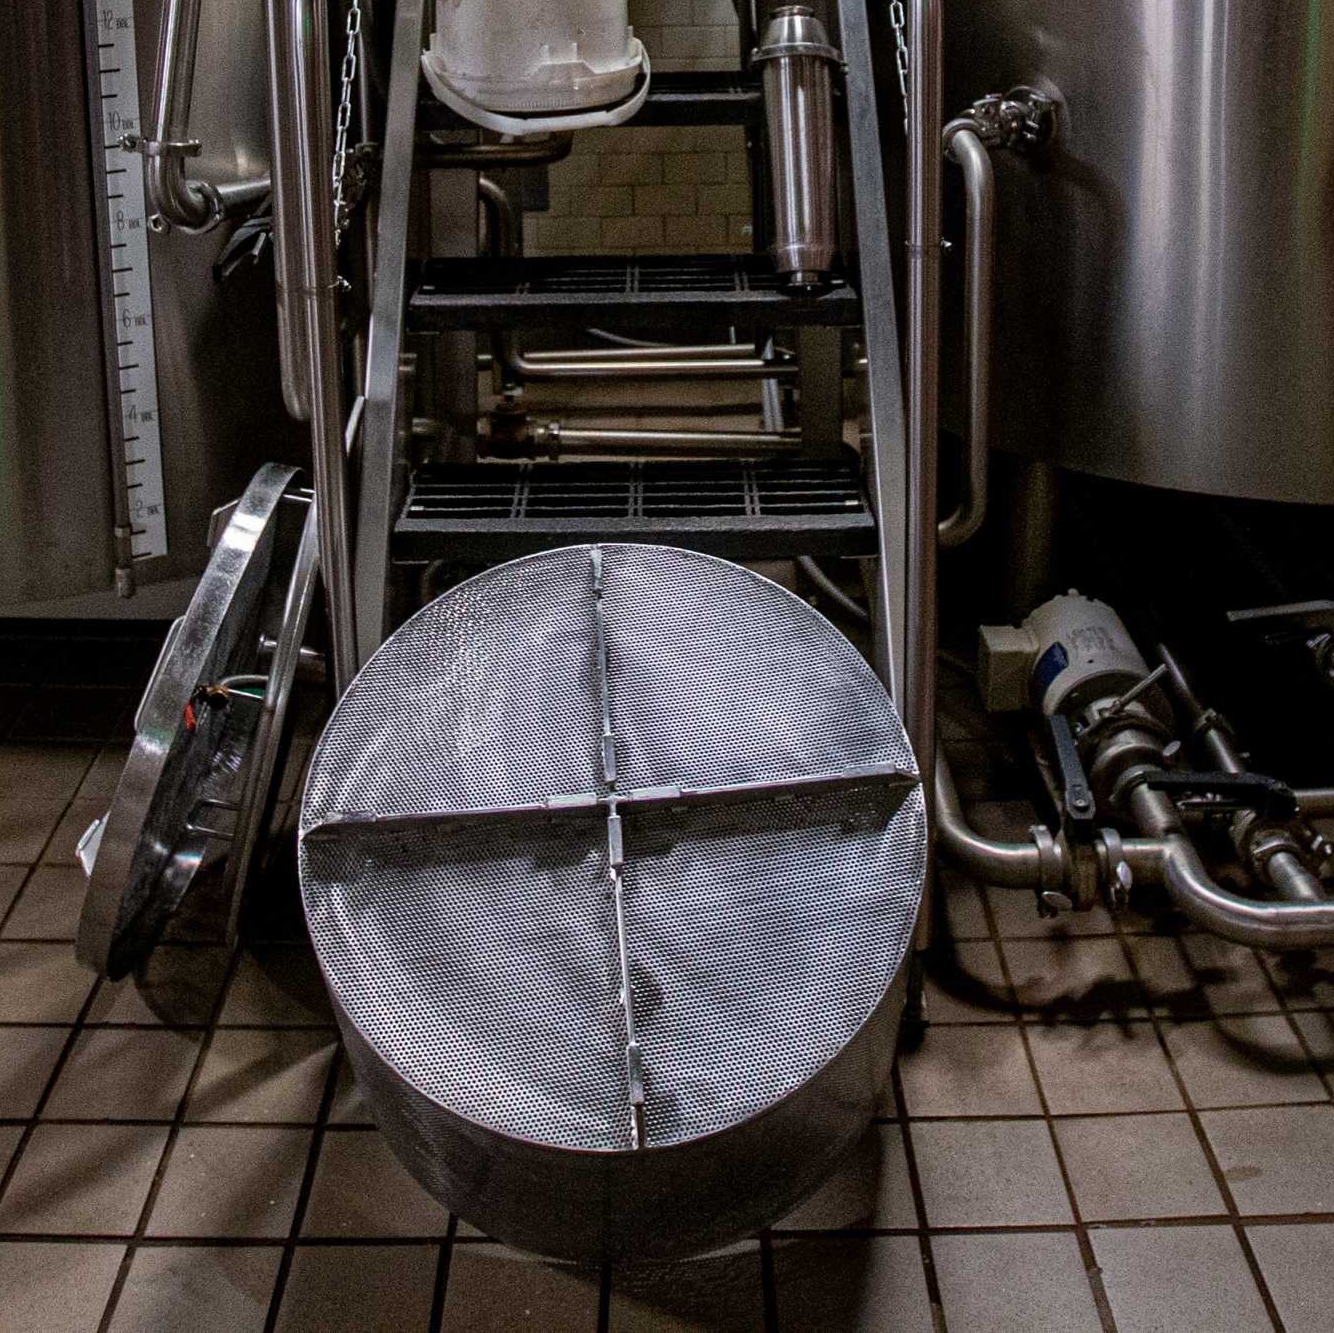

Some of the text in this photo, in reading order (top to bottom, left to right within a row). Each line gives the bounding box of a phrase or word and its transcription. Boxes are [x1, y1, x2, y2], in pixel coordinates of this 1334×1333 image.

[102, 9, 114, 30] 12
[109, 111, 121, 131] 10
[116, 210, 125, 231] 8
[122, 308, 131, 328] 6
[129, 405, 137, 423] 4
